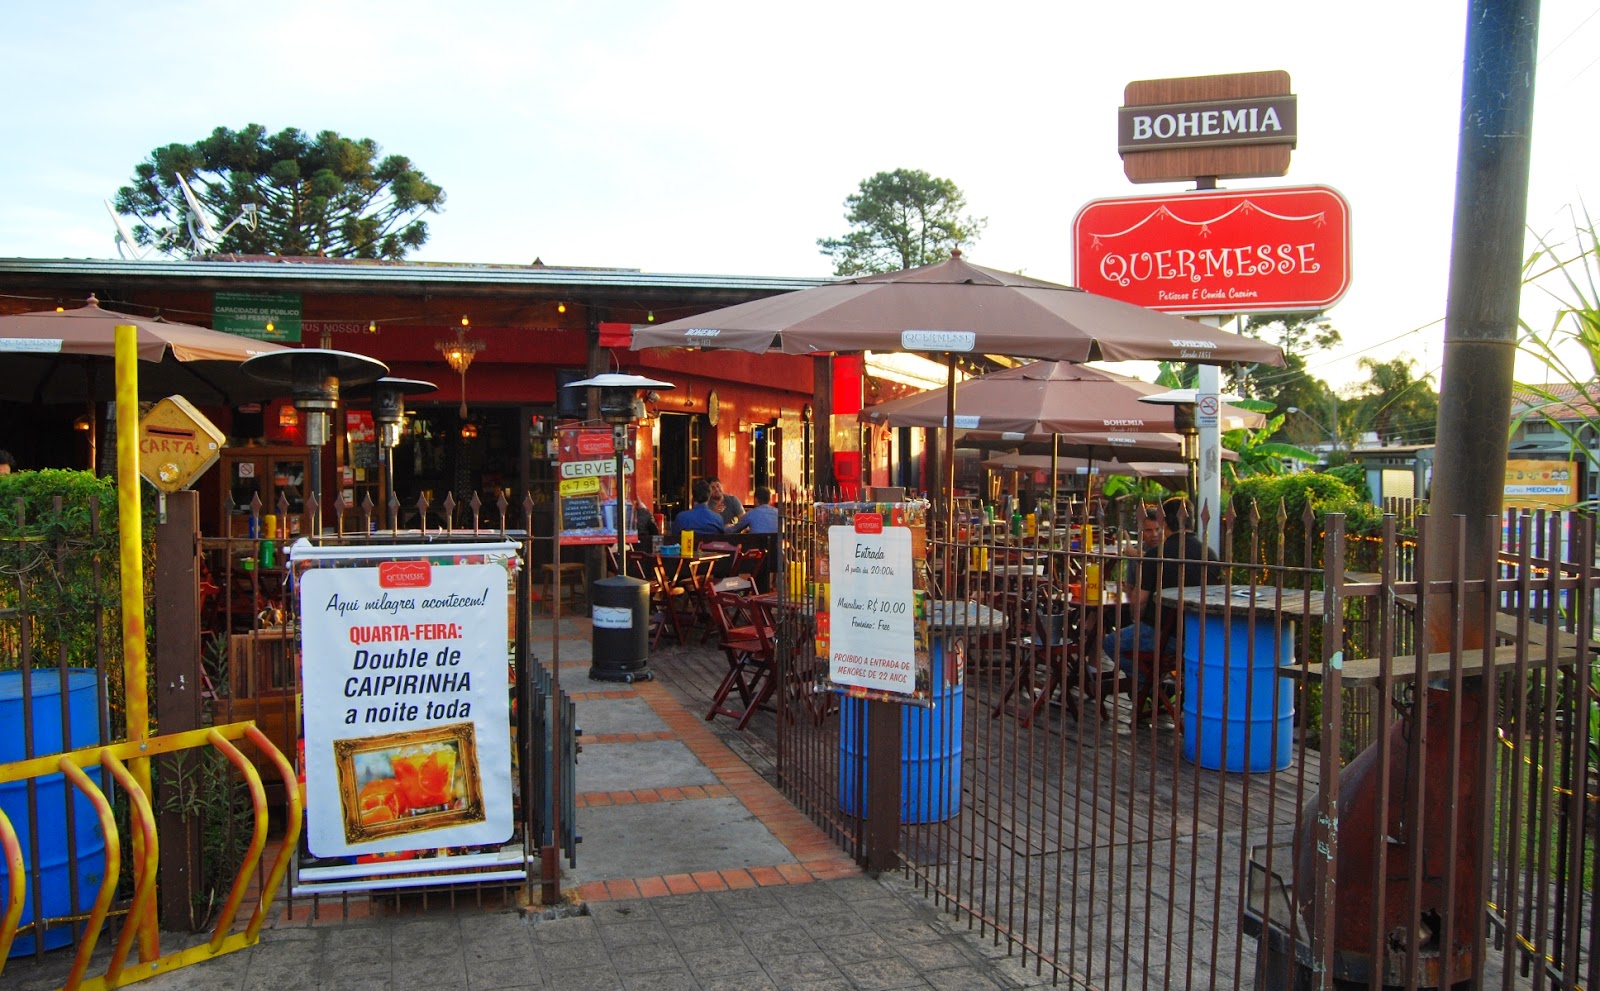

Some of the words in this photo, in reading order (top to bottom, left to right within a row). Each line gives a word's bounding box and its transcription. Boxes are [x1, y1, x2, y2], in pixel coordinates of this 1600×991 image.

[1133, 107, 1282, 140] BOHEMIA
[1100, 243, 1321, 287] QUERMESSE
[1158, 290, 1190, 301] Petiscos
[1191, 288, 1199, 300] E
[1201, 288, 1226, 300] Comida
[1228, 287, 1258, 299] Caseira
[215, 306, 258, 315] CAPACIDADE
[270, 308, 300, 317] PÚBLICO
[247, 314, 279, 322] PESSOAS
[323, 324, 360, 334] NOSSO
[684, 328, 721, 337] BOHEMIA
[905, 333, 972, 344] QUERMESSE
[1169, 339, 1218, 349] BOHEMIA
[564, 461, 631, 476] CERVEA
[855, 543, 885, 560] Entrada
[326, 593, 359, 617] Aqui
[365, 592, 415, 615] milagres
[421, 587, 489, 609] acontecem!
[867, 598, 879, 614] R$
[877, 619, 891, 631] Free
[350, 622, 463, 645] QUARTA-FEIRA:
[353, 647, 429, 671] Double
[435, 646, 462, 667] de
[833, 652, 863, 665] PROIBIDO
[863, 657, 869, 665] A
[869, 658, 900, 669] ENTRADA
[900, 661, 911, 671] DE
[837, 666, 867, 678] MENORES
[867, 669, 878, 679] DE
[878, 671, 889, 681] 22
[889, 672, 908, 684] ANOS
[344, 671, 472, 698] CAIPIRINHA
[344, 708, 358, 725] a
[365, 702, 419, 724] noite
[426, 699, 472, 720] toda
